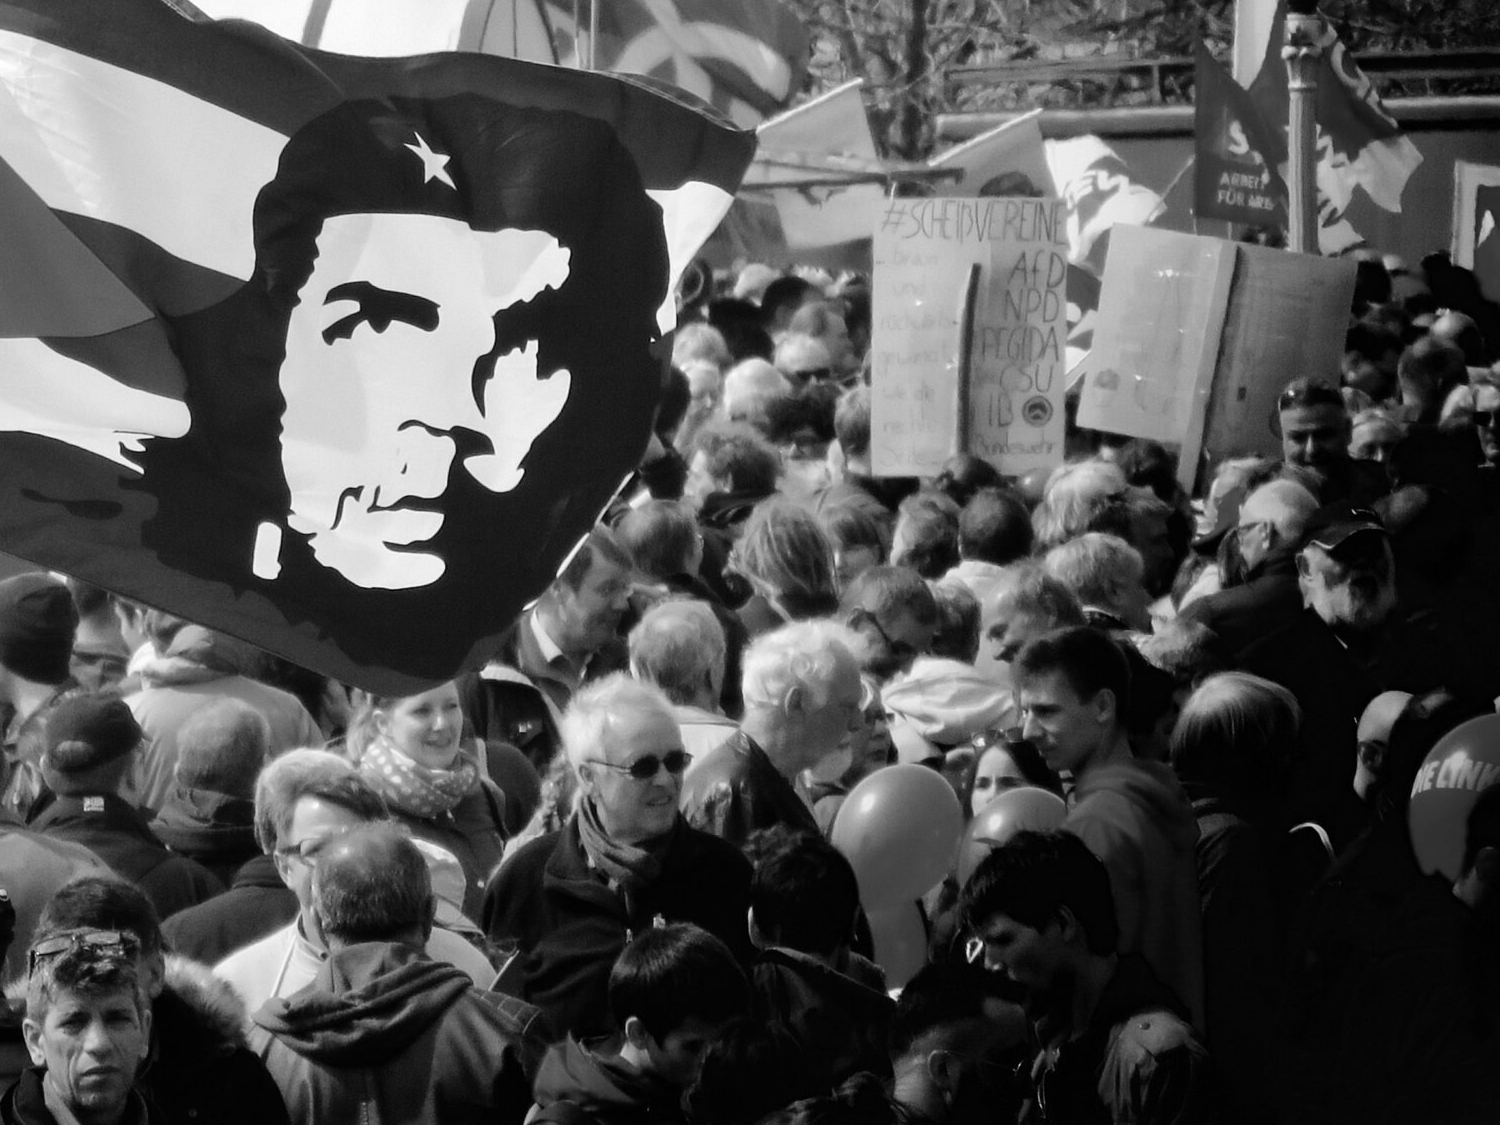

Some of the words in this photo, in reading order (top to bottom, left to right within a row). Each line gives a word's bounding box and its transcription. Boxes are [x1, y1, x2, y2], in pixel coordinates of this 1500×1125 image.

[1007, 249, 1066, 289] AfD
[1004, 288, 1060, 324] NPD
[1000, 362, 1054, 394] CSU
[1436, 758, 1500, 792] LINK
